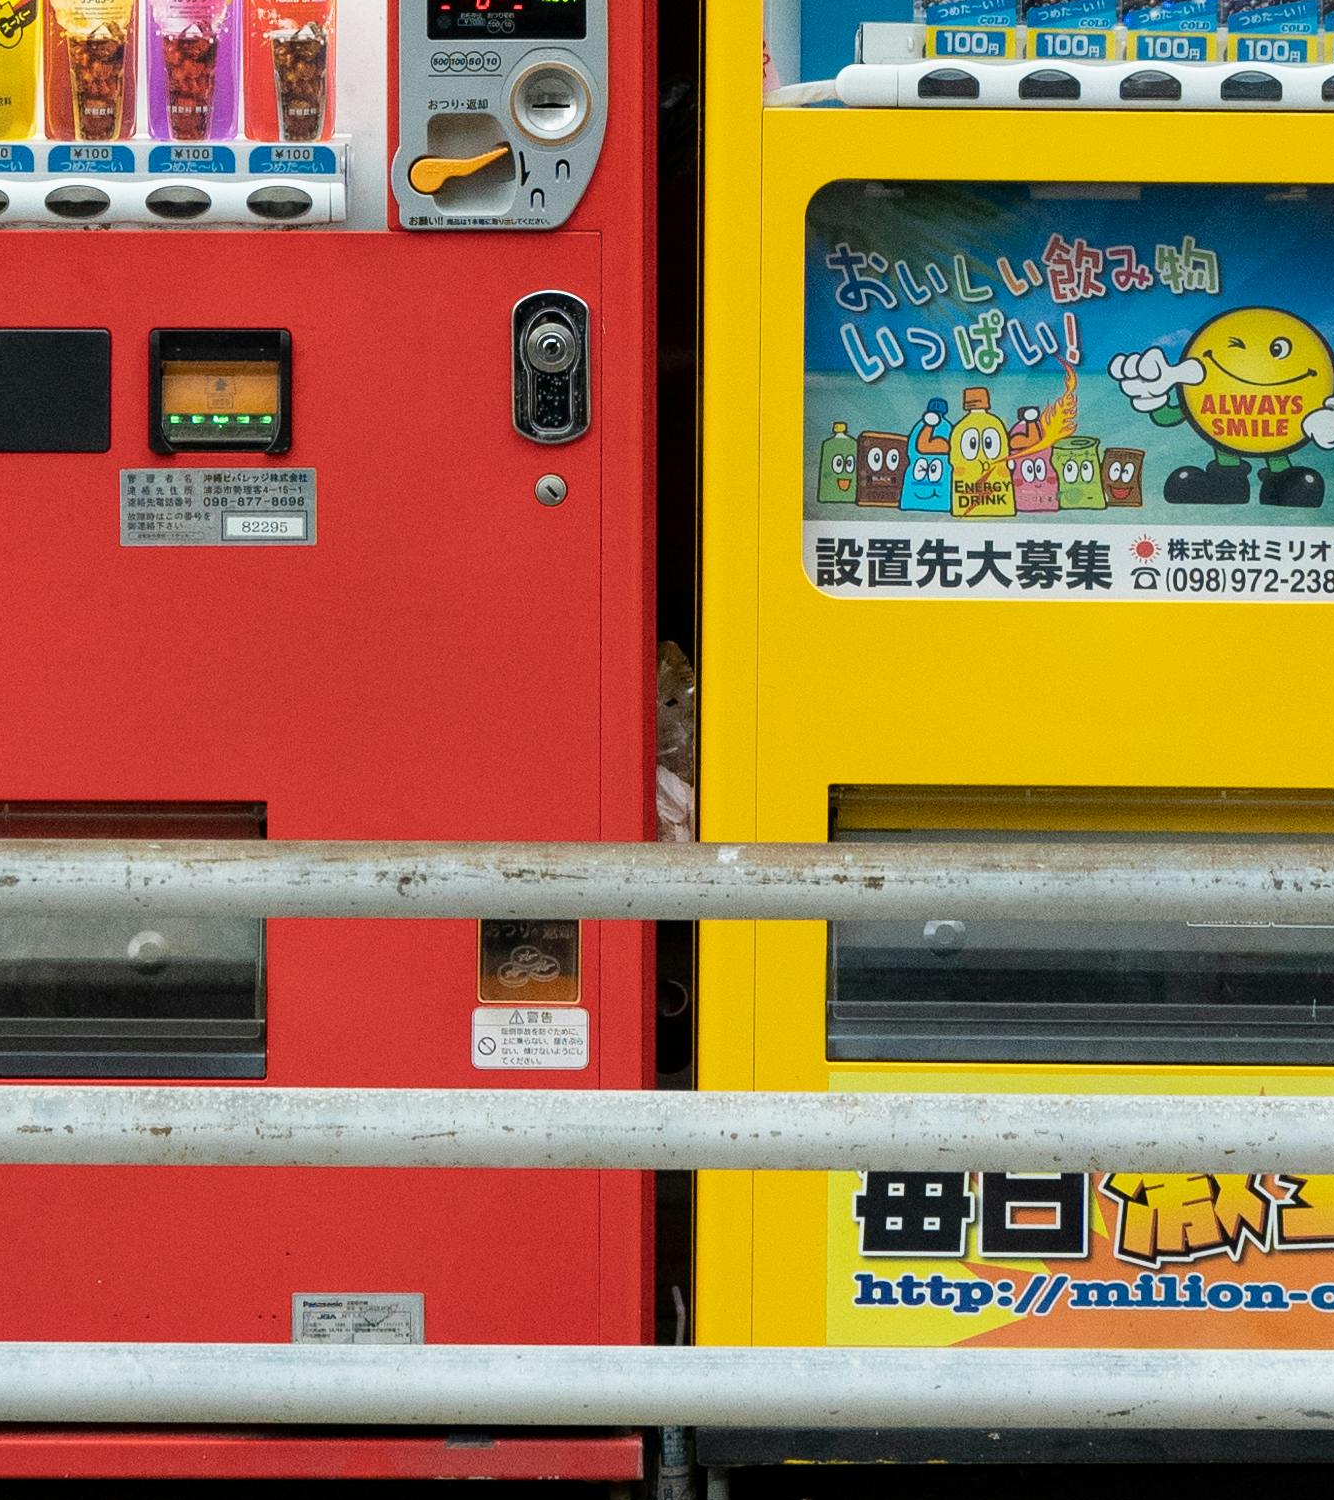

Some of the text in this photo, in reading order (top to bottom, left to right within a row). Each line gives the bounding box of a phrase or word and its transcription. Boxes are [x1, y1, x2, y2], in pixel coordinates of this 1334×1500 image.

[1, 9, 31, 36] スーパー
[978, 16, 1010, 25] COLD
[433, 57, 497, 66] 500 100 50 10
[428, 98, 488, 110] おつり・返却
[826, 232, 1219, 312] おいしい飲み物
[839, 312, 1082, 384] いっぱい!
[1200, 393, 1304, 416] ALWAYS
[1211, 418, 1289, 437] SMILE
[954, 479, 1011, 495] ENERGY
[203, 497, 304, 507] 098-877-8698
[957, 494, 1008, 509] DRINK
[242, 522, 288, 533] 82295
[815, 537, 1113, 591] 設置先大募集
[527, 1012, 553, 1024] 警告
